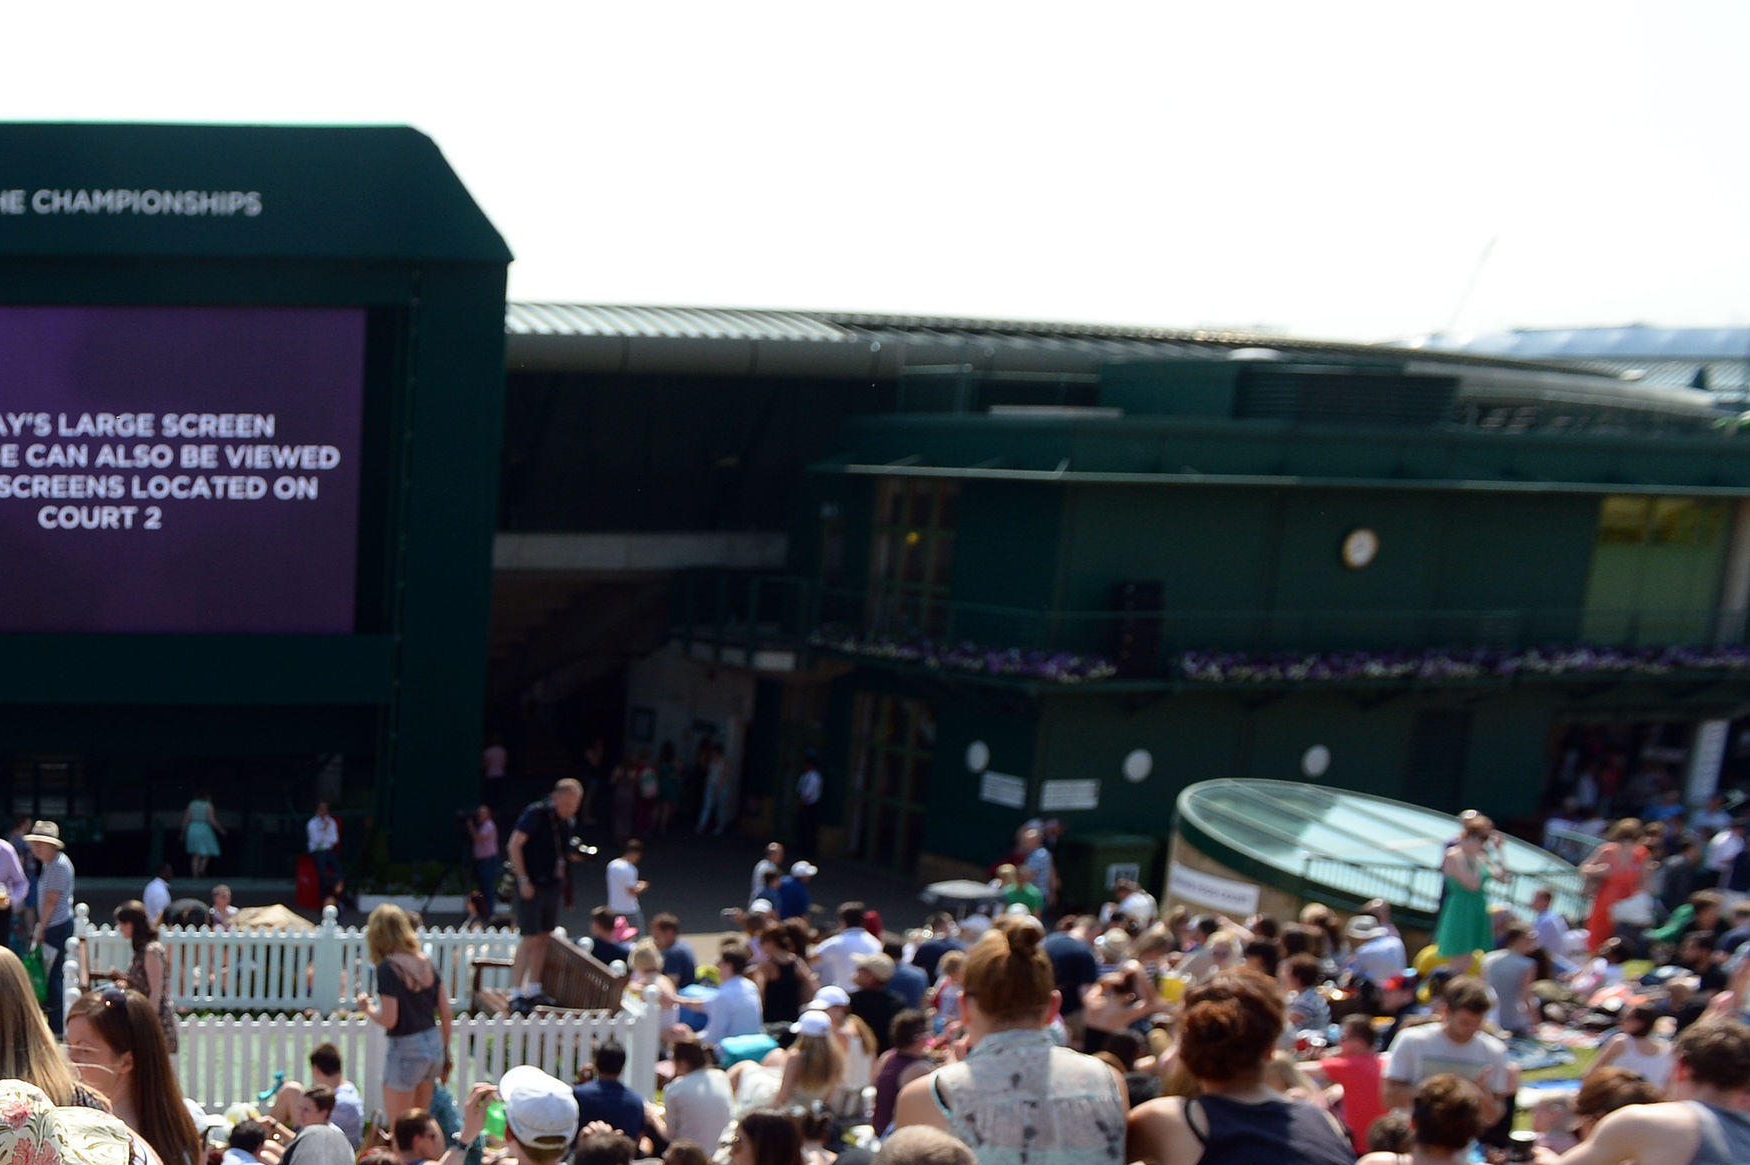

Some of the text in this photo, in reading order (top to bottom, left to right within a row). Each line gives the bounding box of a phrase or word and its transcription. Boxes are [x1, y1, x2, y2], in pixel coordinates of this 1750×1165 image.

[32, 189, 263, 217] CHAMPIONSHIPS
[58, 412, 155, 438] LARGE
[161, 413, 276, 439] SCREEN
[25, 443, 88, 468] CAN
[95, 444, 174, 469] ALSO
[180, 444, 218, 469] BE
[224, 444, 341, 470] VIEWED
[131, 475, 267, 500] LOCATED
[273, 475, 318, 500] ON
[37, 504, 162, 530] COURT 2
